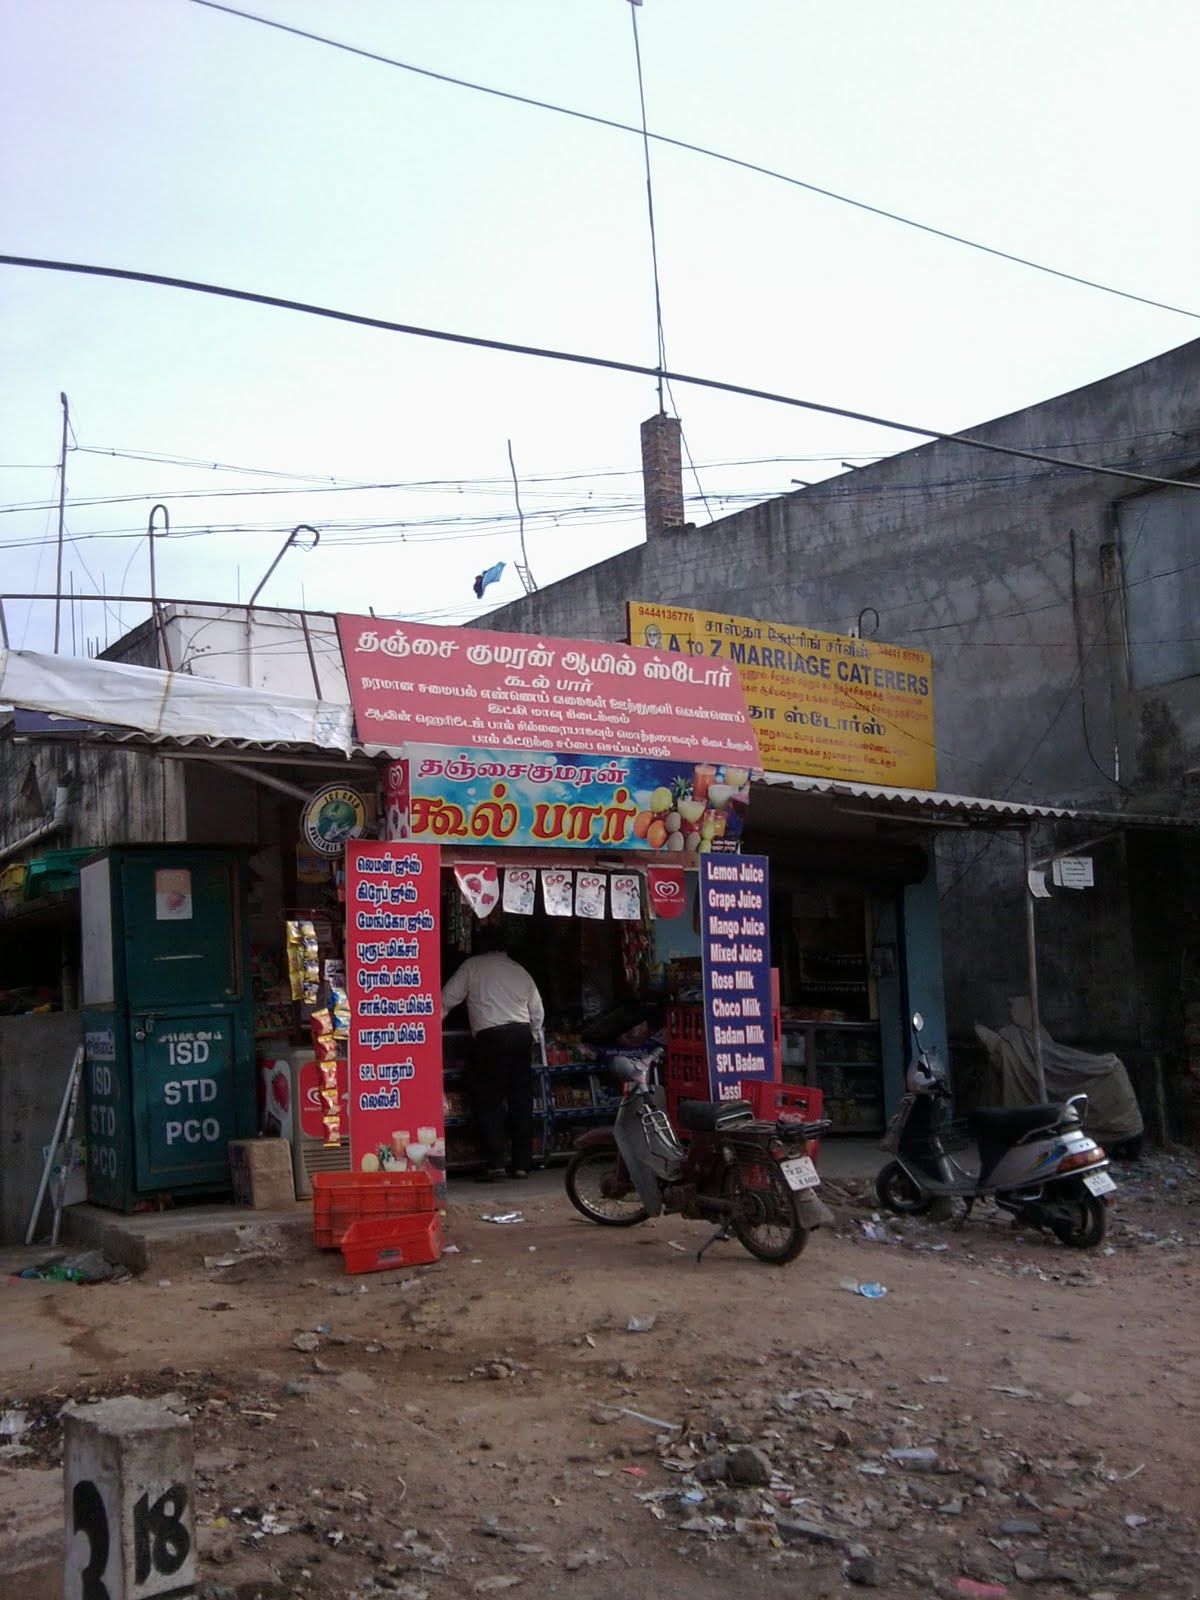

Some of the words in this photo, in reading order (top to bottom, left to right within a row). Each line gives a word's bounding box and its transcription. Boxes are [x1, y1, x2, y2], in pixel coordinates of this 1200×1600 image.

[355, 630, 459, 658] தஞ்சை
[466, 643, 556, 669] குமரன்
[561, 652, 636, 676] ஆயில்
[643, 656, 732, 687] ஸ்டோர்
[668, 633, 681, 652] A
[710, 639, 723, 657] Z
[729, 642, 831, 680] MARRIAGE
[837, 660, 930, 697] CATERERS
[504, 675, 550, 689] கூல்
[556, 678, 594, 693] பார்
[361, 676, 414, 691] தரமான
[418, 684, 477, 698] சமையல்
[480, 687, 550, 703] எண்ணெய்
[553, 695, 607, 708] வகைகள்
[675, 706, 746, 724] வெண்ணெய்
[365, 707, 412, 721] ஆவின்
[487, 719, 515, 731] பால்
[488, 703, 528, 716] இட்லி
[531, 708, 563, 721] மாவு
[566, 711, 630, 724] கிடைக்கும்
[784, 705, 886, 736] ஸ்டோர்ஸ்
[472, 733, 500, 745] பால்
[417, 753, 629, 788] தஞ்சைகுமரன்
[410, 781, 519, 838] கூல்
[529, 786, 637, 842] பார்
[310, 826, 338, 852] AVAILABLE
[356, 852, 393, 873] லெமன்
[394, 853, 422, 877] ஜூஸ்
[707, 861, 738, 881] Lemon
[740, 863, 764, 883] Juice
[356, 879, 389, 907] கிரேப்
[390, 881, 417, 906] ஜூஸ்
[708, 888, 736, 912] Grape
[737, 889, 762, 909] Juice
[356, 908, 406, 930] மேங்கோ
[407, 909, 434, 933] ஜூஸ்
[709, 916, 739, 939] Mango
[741, 916, 765, 936] Juice
[386, 937, 419, 959] மிக்சர்
[710, 943, 737, 962] Mixed
[739, 943, 763, 963] Juice
[357, 965, 391, 993] ரோஸ்
[392, 966, 421, 987] மில்க்
[711, 970, 734, 990] Rose
[735, 970, 754, 990] Milk
[358, 995, 404, 1016] சாக்லேட்
[405, 994, 433, 1015] மில்க்
[712, 998, 740, 1017] Choco
[742, 998, 761, 1017] Milk
[359, 1023, 395, 1049] பாதாம்
[397, 1022, 425, 1044] மில்க்
[714, 1026, 745, 1045] Badam
[745, 1025, 765, 1044] Milk
[168, 1040, 210, 1066] ISD
[716, 1053, 734, 1072] SPL
[735, 1053, 765, 1072] Badam
[92, 1066, 111, 1096] ISD
[360, 1064, 375, 1081] SPL
[378, 1057, 414, 1084] பாதாம்
[164, 1079, 217, 1106] STD
[360, 1087, 400, 1110] லெஸ்சி
[718, 1081, 741, 1100] Lassi
[91, 1104, 116, 1137] STD
[166, 1118, 220, 1145] PCO
[133, 1482, 190, 1586] 18
